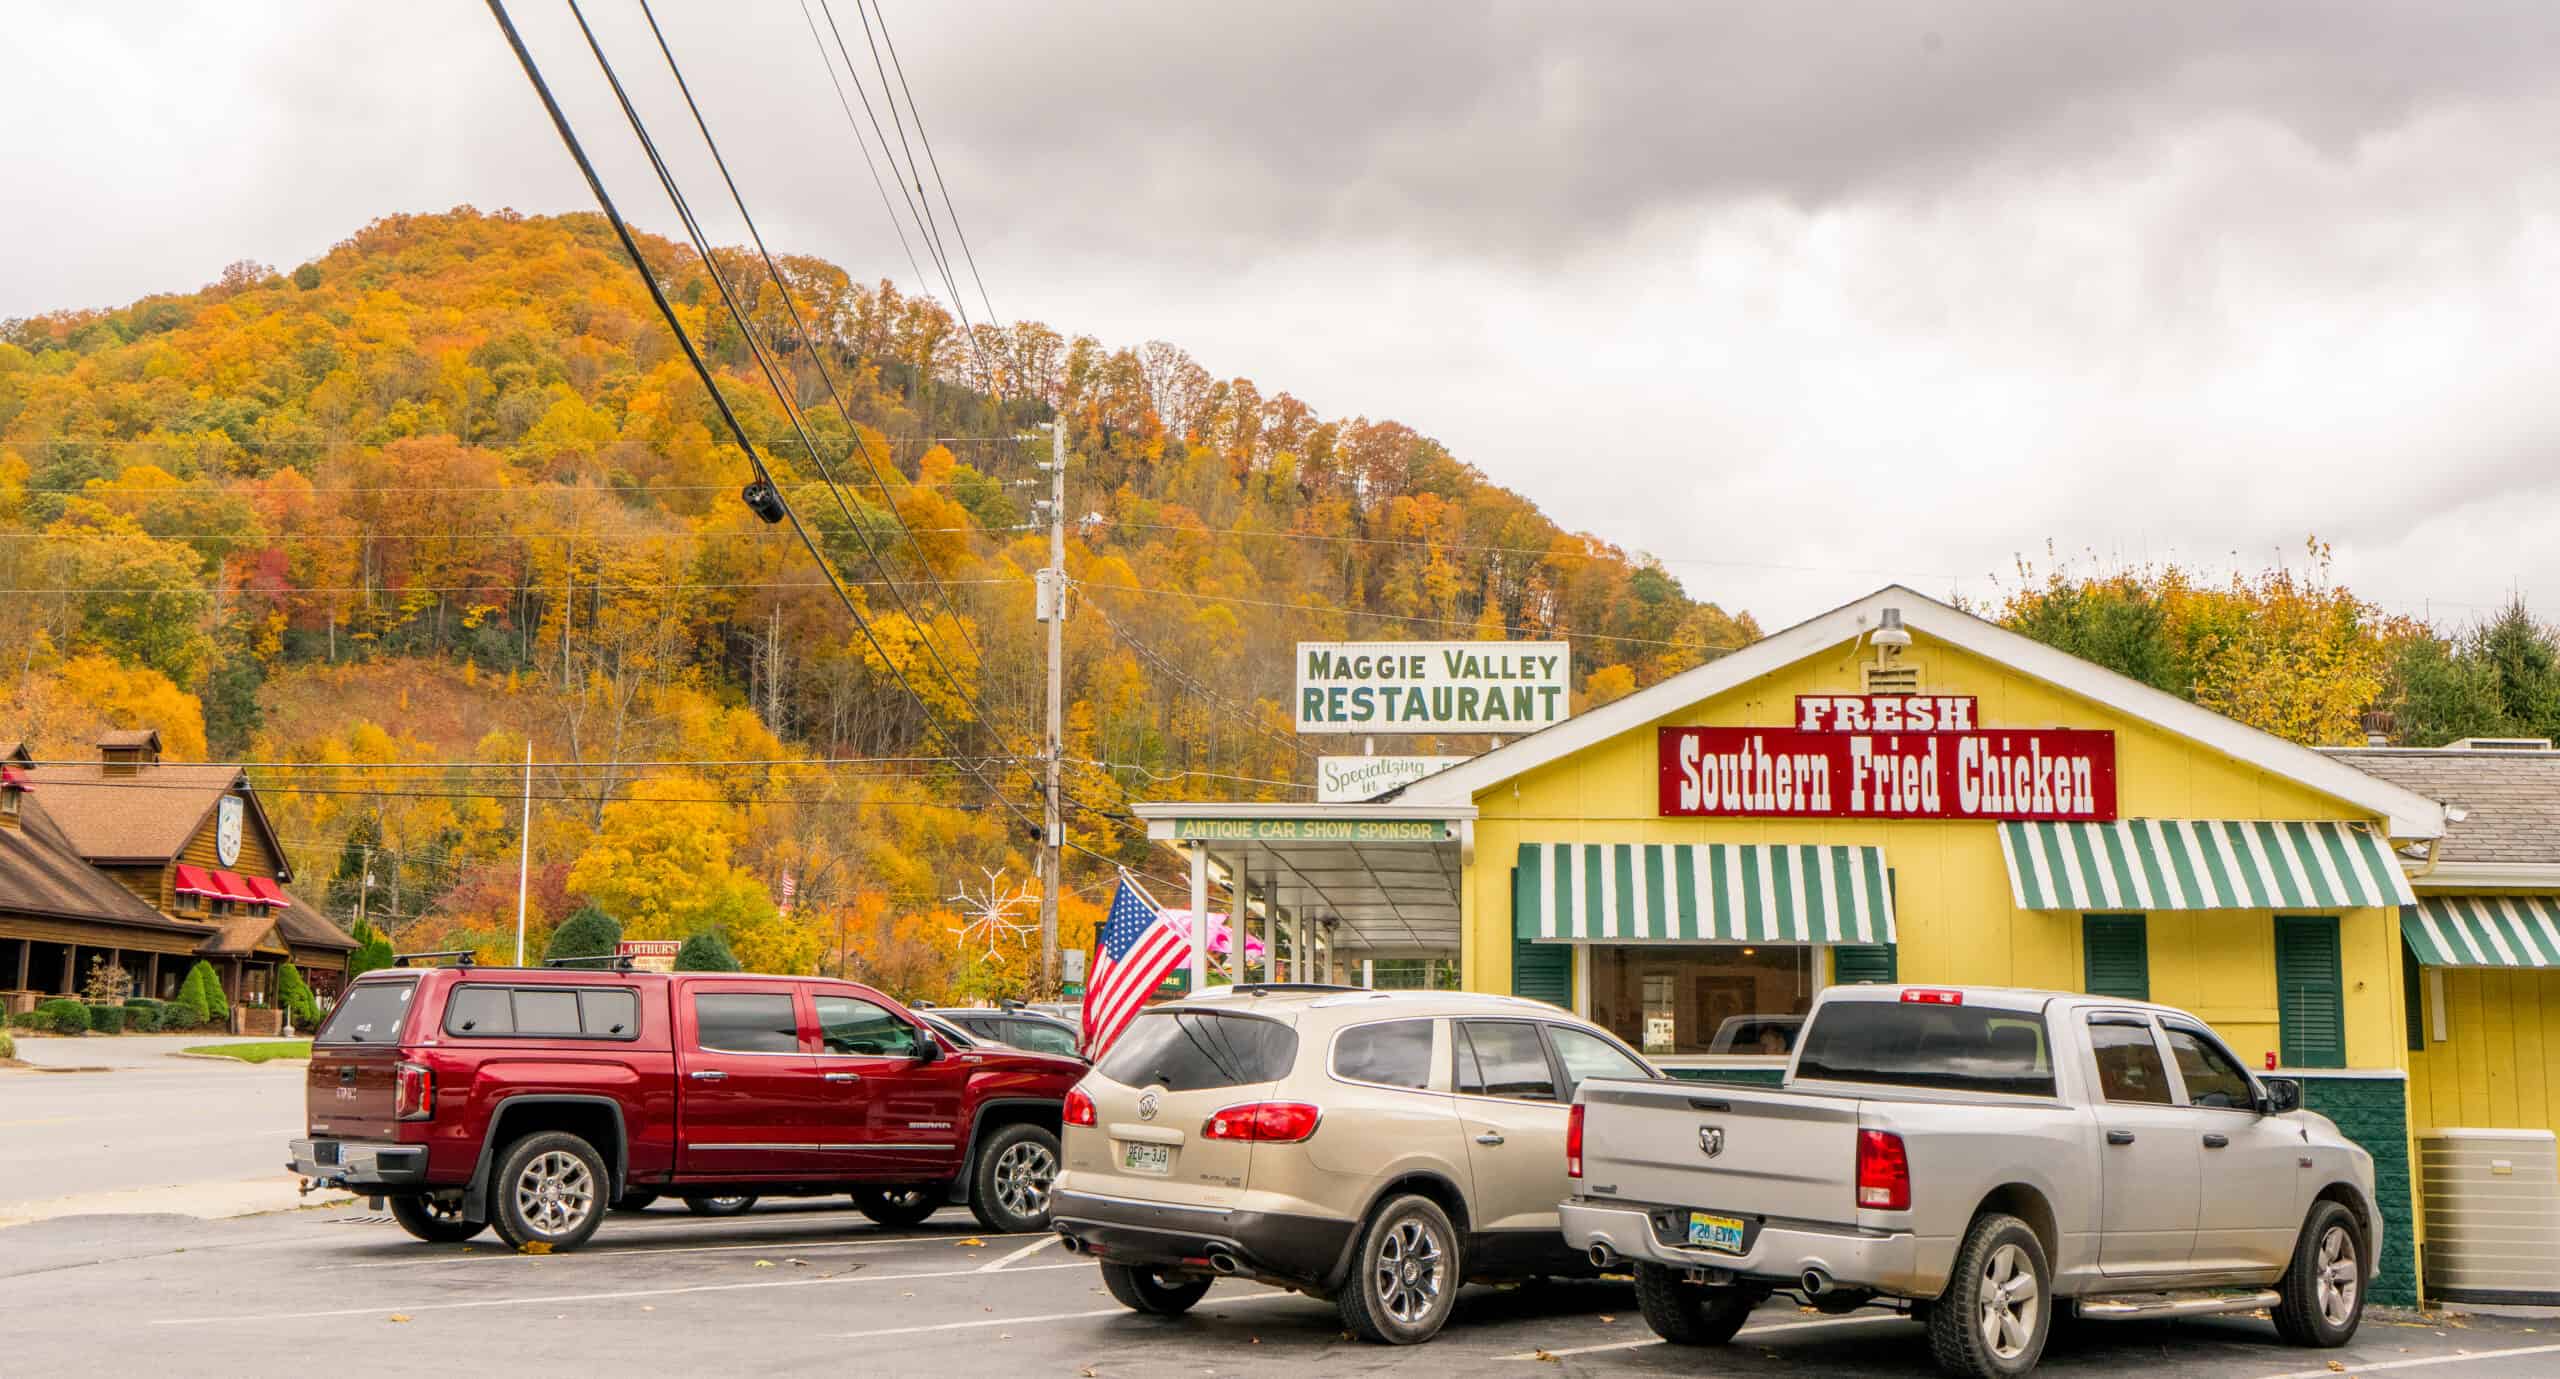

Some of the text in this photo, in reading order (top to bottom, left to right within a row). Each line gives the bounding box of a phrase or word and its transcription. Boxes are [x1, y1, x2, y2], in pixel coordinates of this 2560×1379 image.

[1308, 649, 1558, 679] MAGGIE VALLEY
[1302, 686, 1561, 722] RESTAURANT
[1800, 697, 1974, 731] FRESH
[1324, 758, 1425, 793] Specializing
[1679, 734, 2095, 814] Southern Fried Chicken
[1182, 819, 1433, 840] ANTIQUE CAR SHOW SPONSOR
